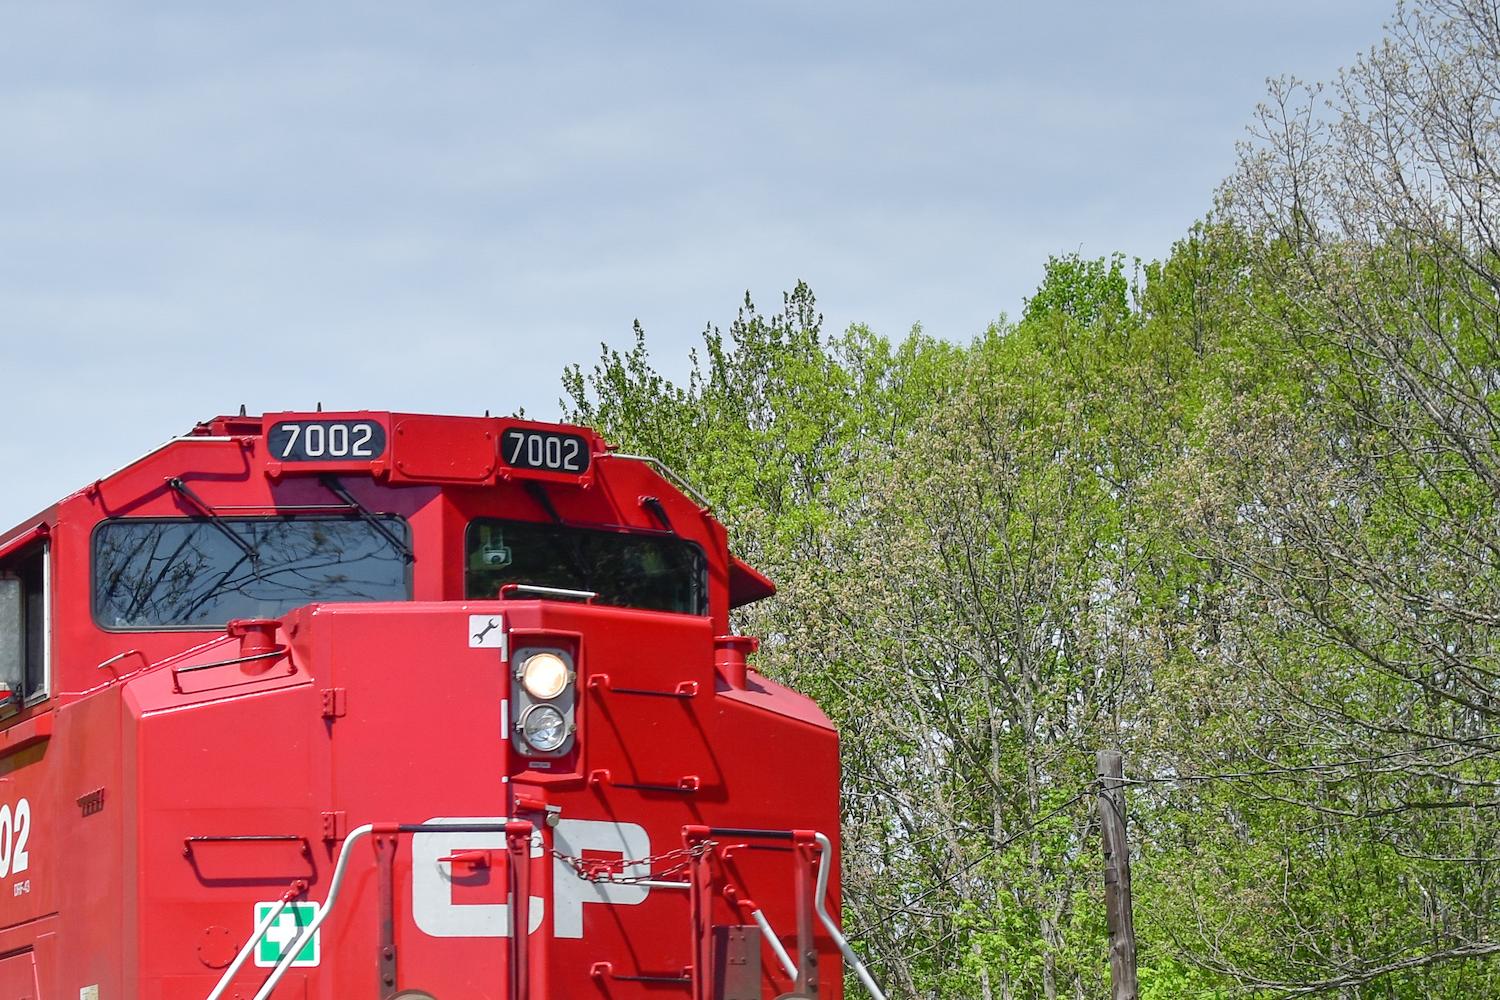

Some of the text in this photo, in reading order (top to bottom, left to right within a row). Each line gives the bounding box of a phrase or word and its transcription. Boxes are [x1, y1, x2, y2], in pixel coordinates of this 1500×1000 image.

[281, 424, 373, 458] 7002
[509, 431, 580, 471] 7002
[412, 817, 651, 939] CP
